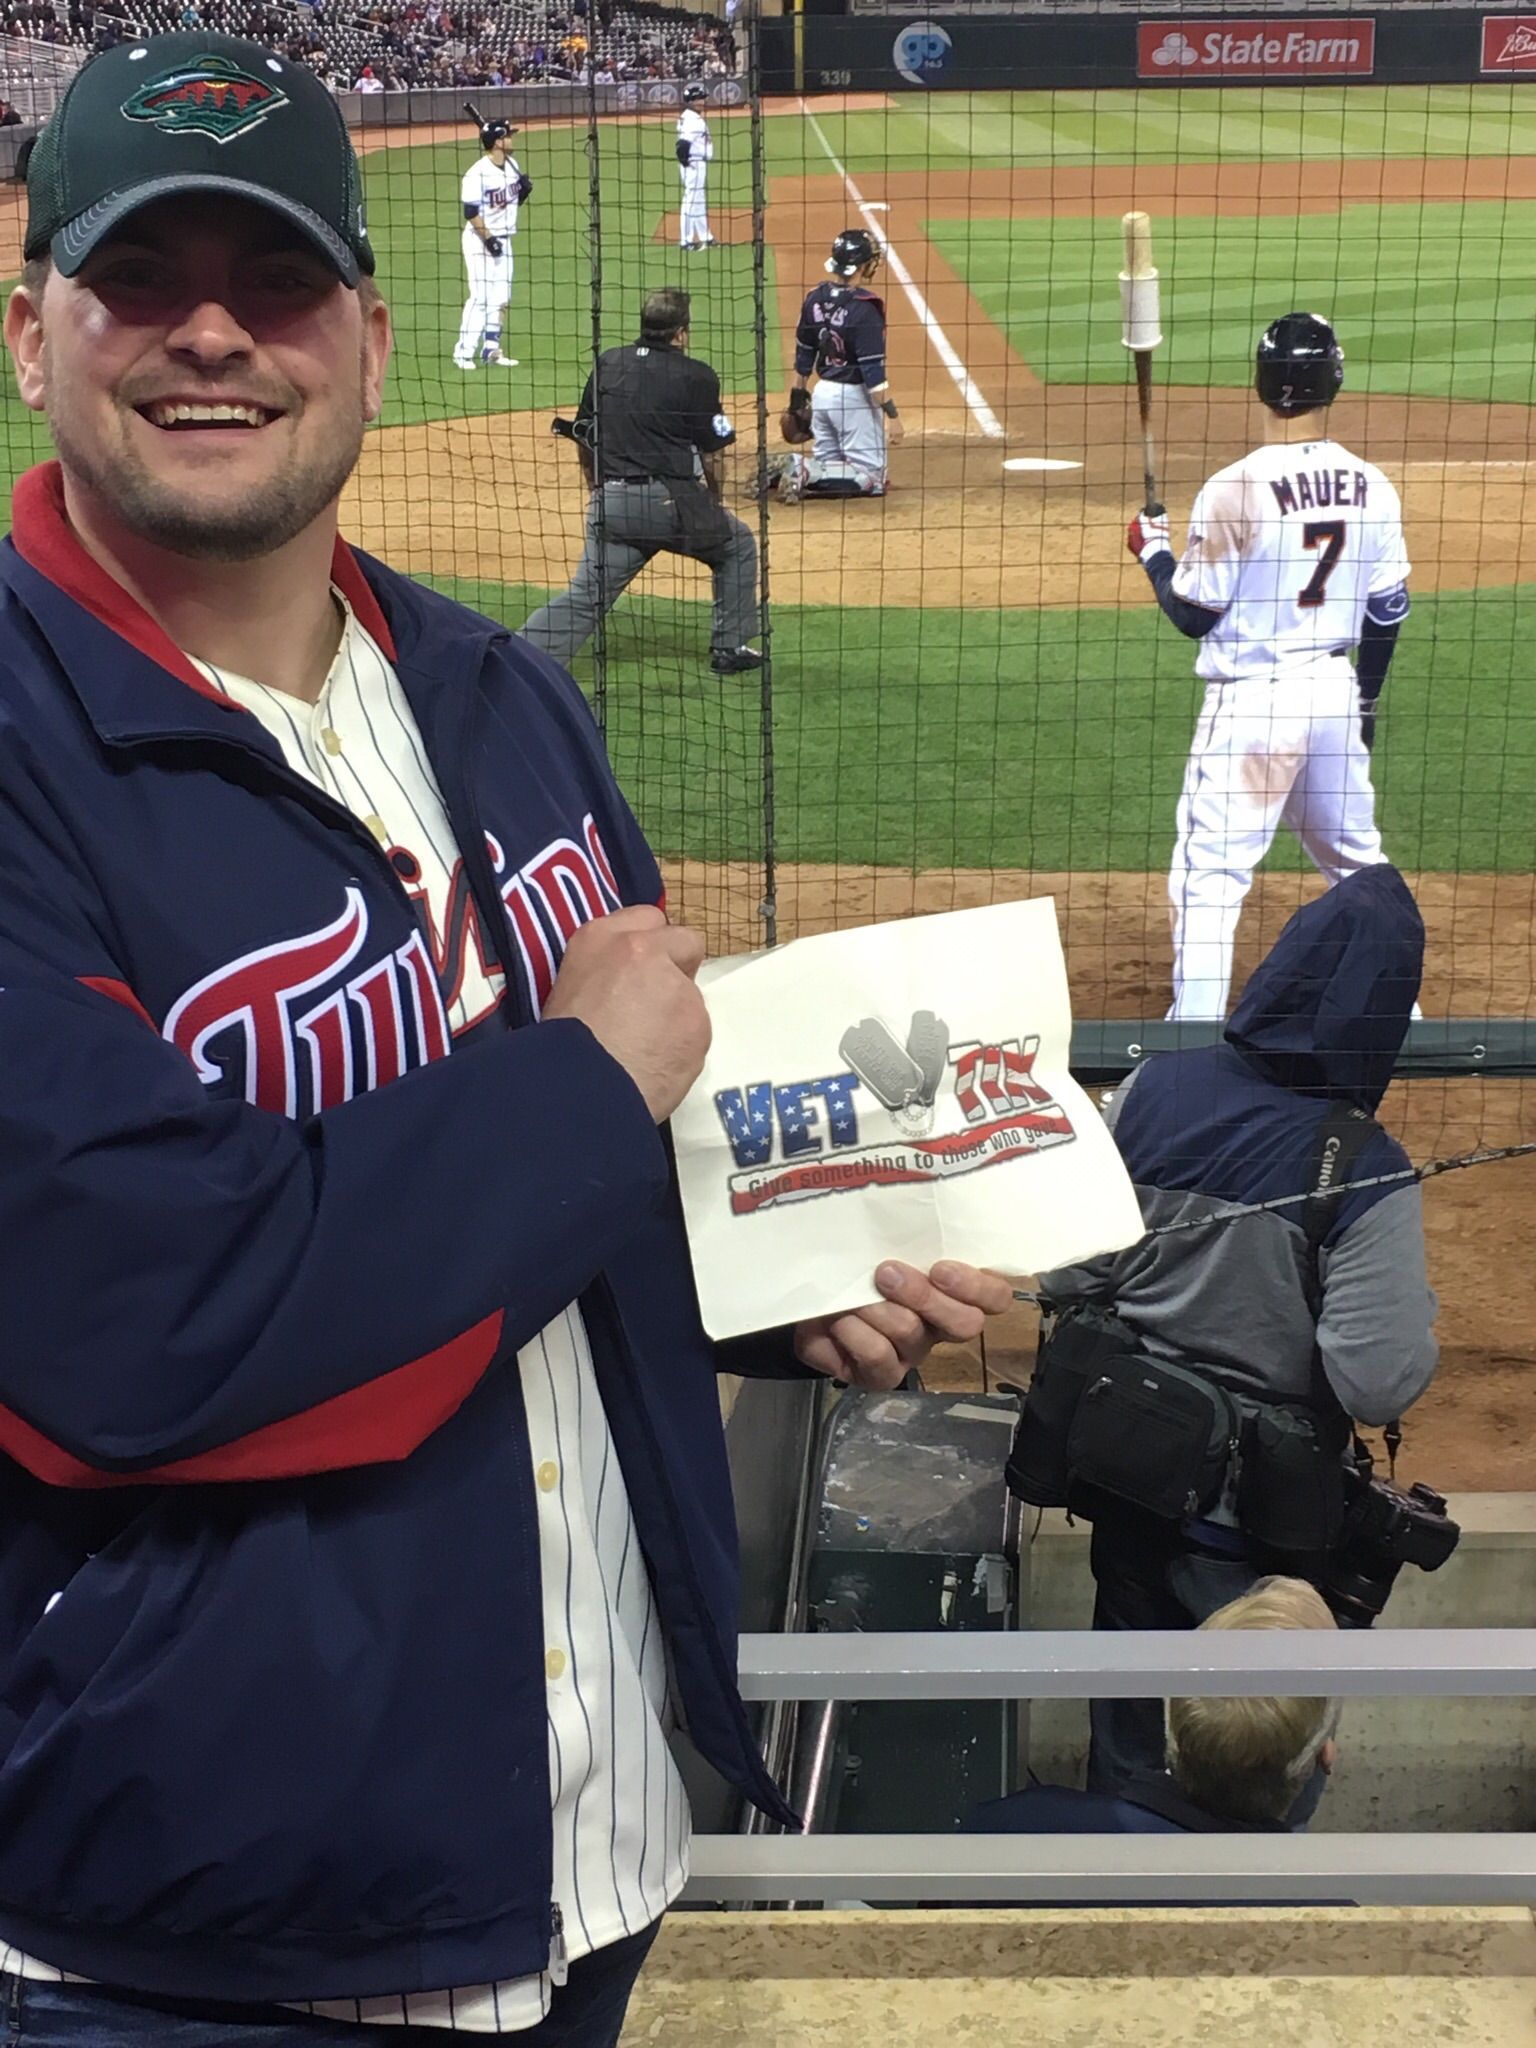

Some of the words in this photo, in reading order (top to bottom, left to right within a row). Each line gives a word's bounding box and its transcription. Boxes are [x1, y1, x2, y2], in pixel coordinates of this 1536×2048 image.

[1269, 469, 1368, 516] MAUER
[1297, 519, 1346, 609] 7
[714, 1073, 861, 1168] VET
[947, 1034, 1054, 1122] TIK
[748, 1176, 793, 1198] Give
[800, 1154, 906, 1188] something
[914, 1152, 935, 1170] to
[942, 1139, 988, 1165] those
[990, 1128, 1021, 1151] who
[1024, 1120, 1057, 1143] gave
